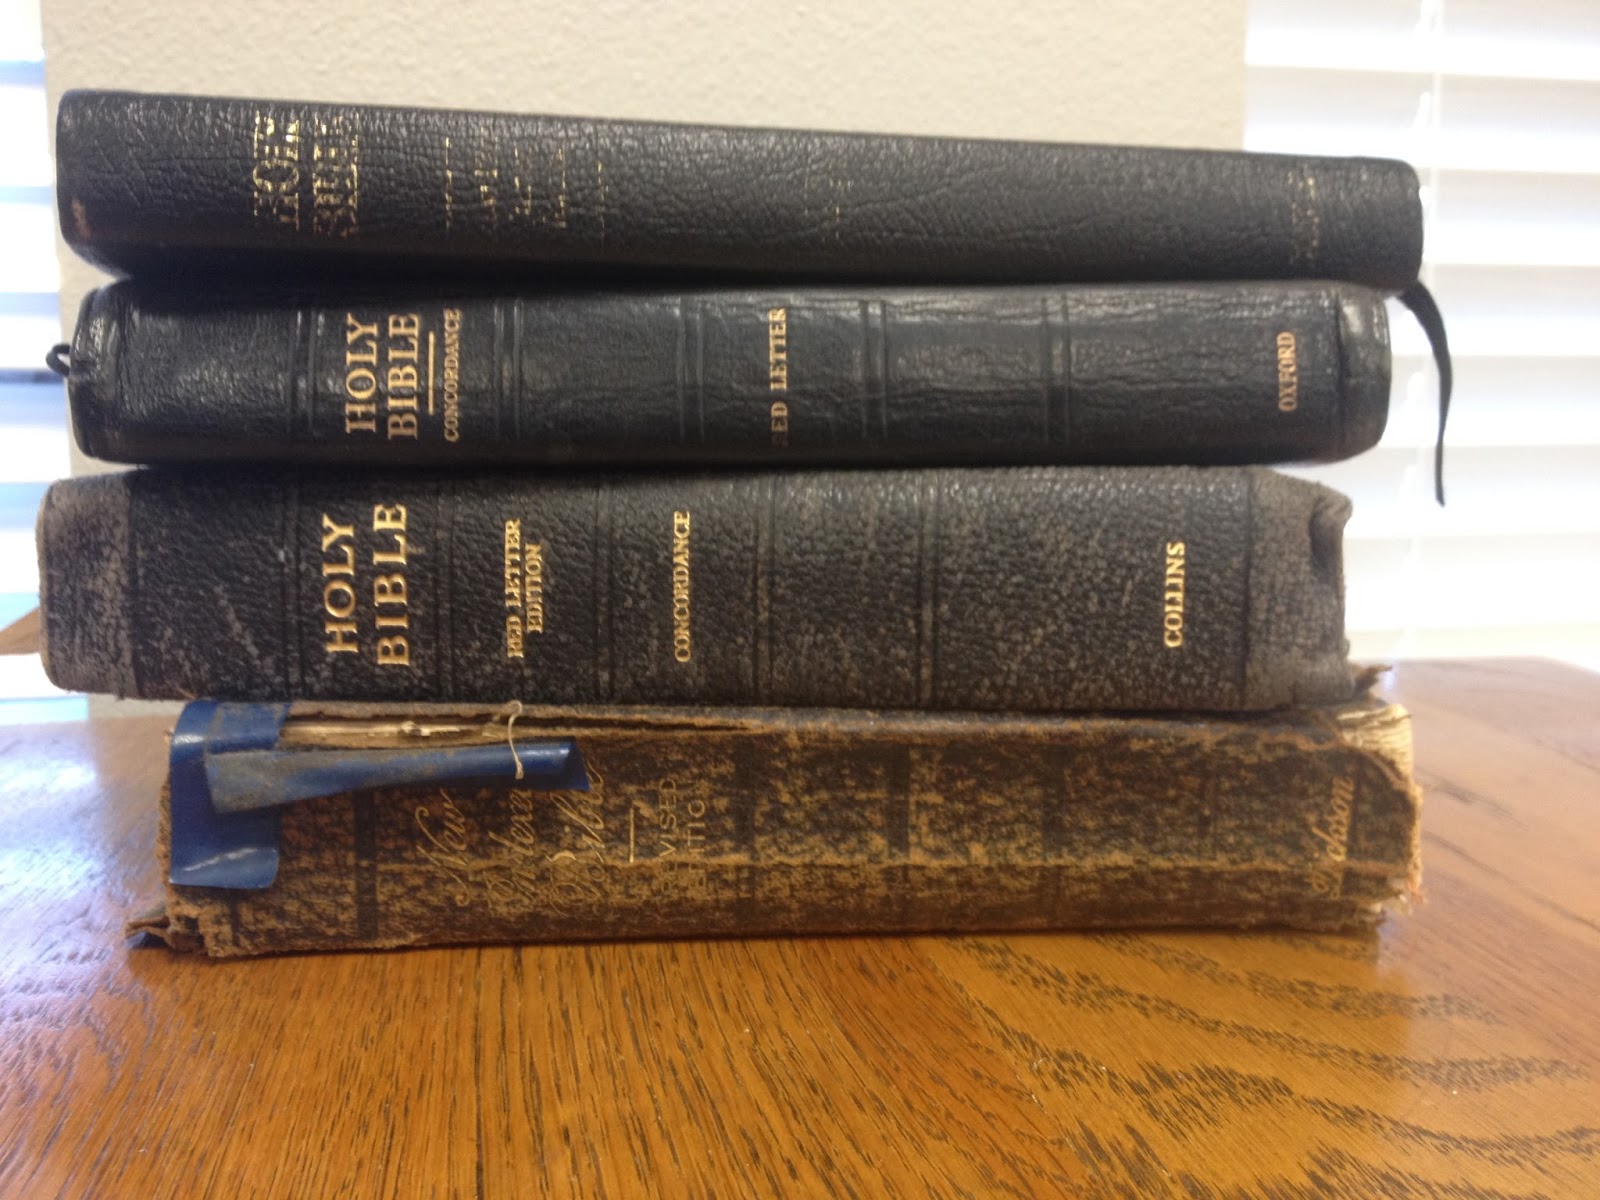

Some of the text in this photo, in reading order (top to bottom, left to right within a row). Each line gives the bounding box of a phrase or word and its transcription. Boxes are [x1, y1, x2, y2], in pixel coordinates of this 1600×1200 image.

[345, 312, 378, 434] HOLY
[387, 313, 419, 440] BIBLE
[443, 308, 462, 442] CONCORDANCE
[768, 308, 787, 391] LETTER
[1276, 331, 1297, 412] OXFORD
[321, 513, 359, 654] HOLY
[372, 503, 409, 666] BIBLE
[505, 519, 525, 658] RED LETTER
[525, 543, 544, 633] EDITION
[673, 511, 691, 663] CONCORDANCE
[1163, 541, 1186, 648] COLLINS
